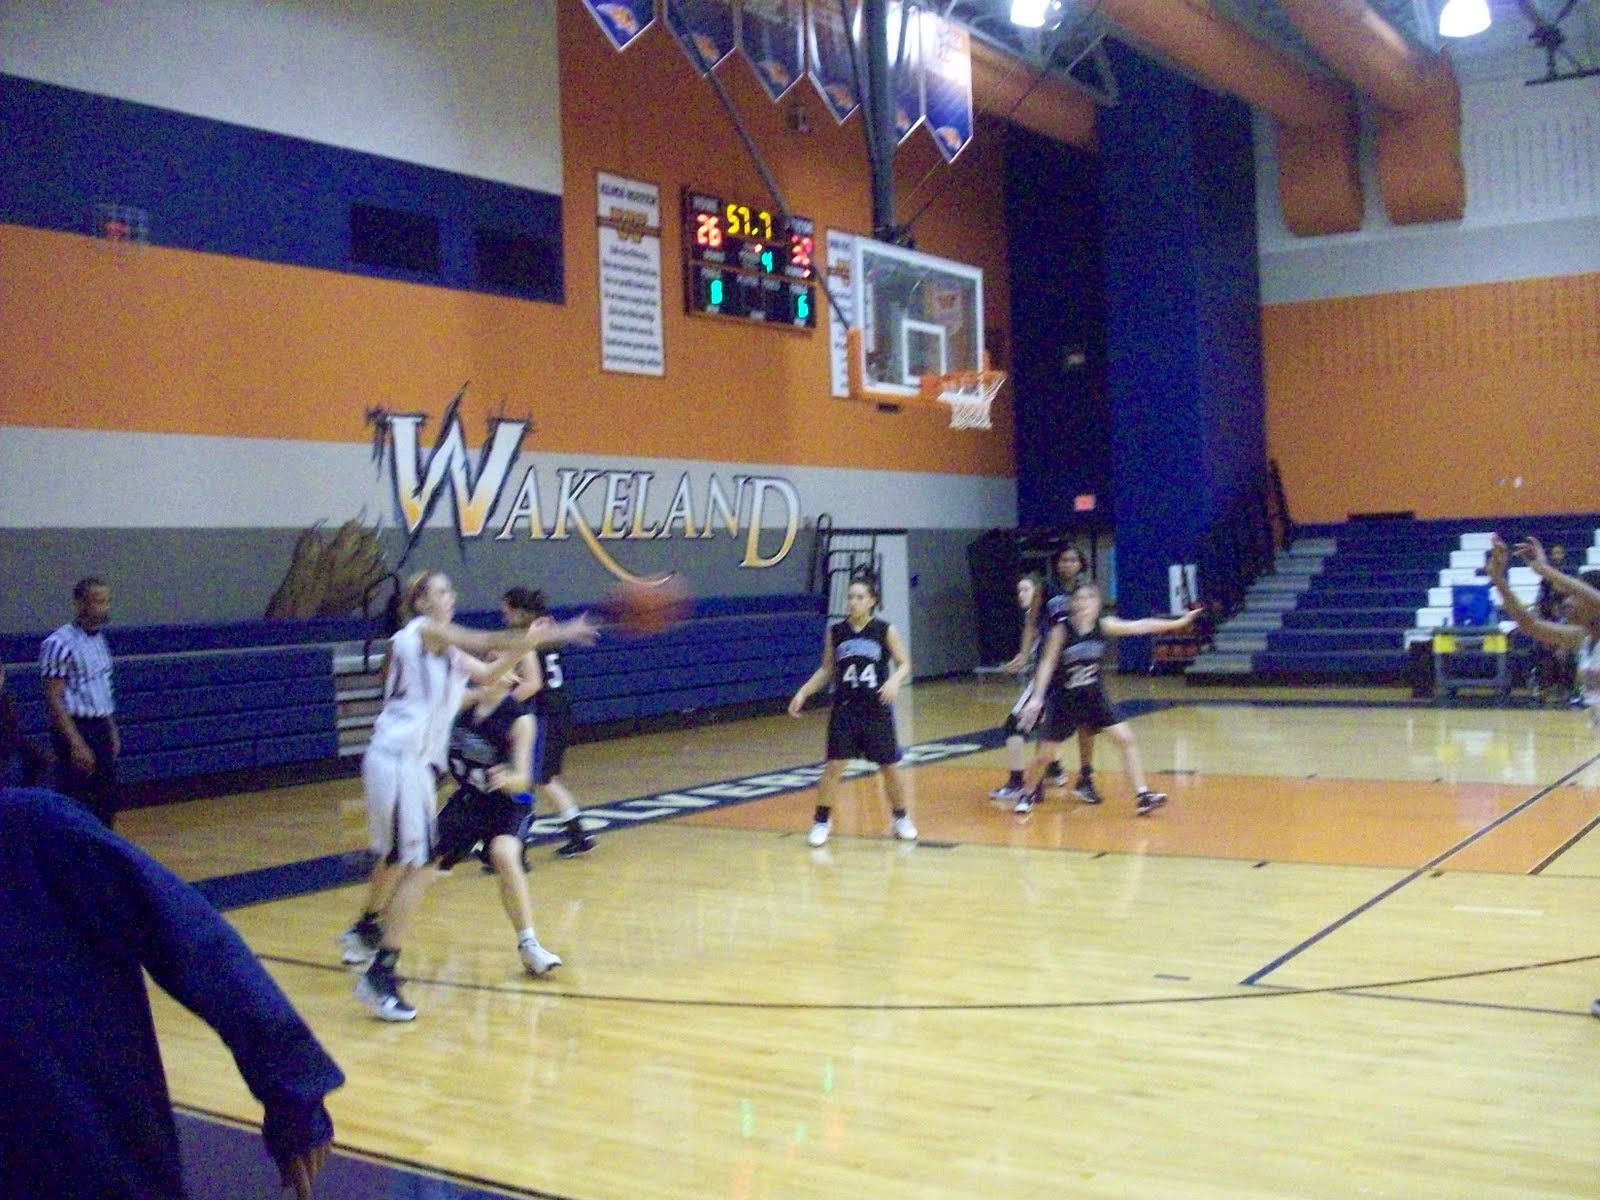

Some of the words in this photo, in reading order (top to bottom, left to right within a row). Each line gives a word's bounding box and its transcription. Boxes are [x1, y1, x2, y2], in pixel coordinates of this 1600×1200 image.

[726, 203, 772, 240] 57.7
[367, 383, 801, 584] WAKELAND
[842, 662, 879, 690] 44
